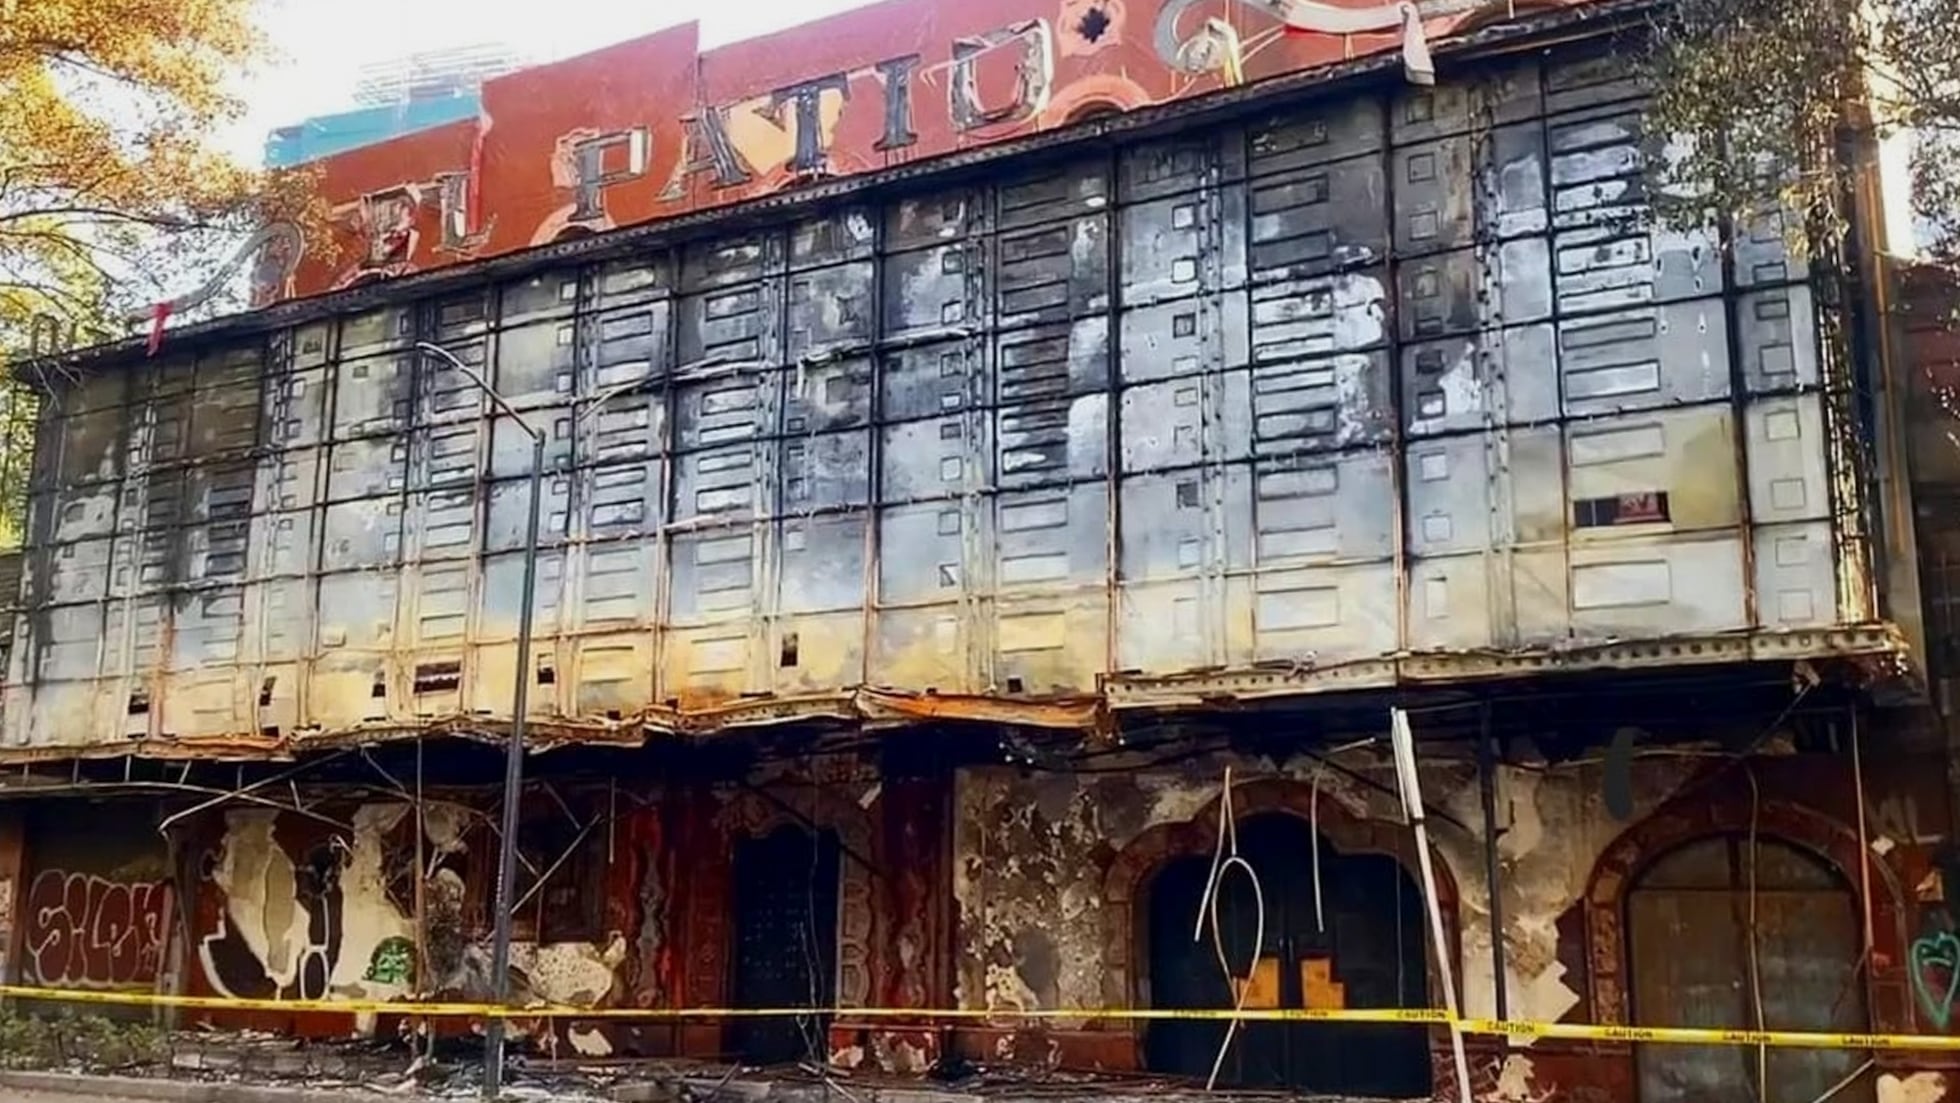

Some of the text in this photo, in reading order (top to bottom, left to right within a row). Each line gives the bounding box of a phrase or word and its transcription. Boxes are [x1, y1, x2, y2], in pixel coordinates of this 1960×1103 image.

[563, 18, 1054, 221] PATIO
[1396, 1010, 1447, 1020] CAUTION
[1486, 1021, 1535, 1034] CAUTION
[1604, 1029, 1654, 1040] CAUTION
[1722, 1032, 1773, 1042] CAUTION
[1841, 1035, 1892, 1046] CAUTION
